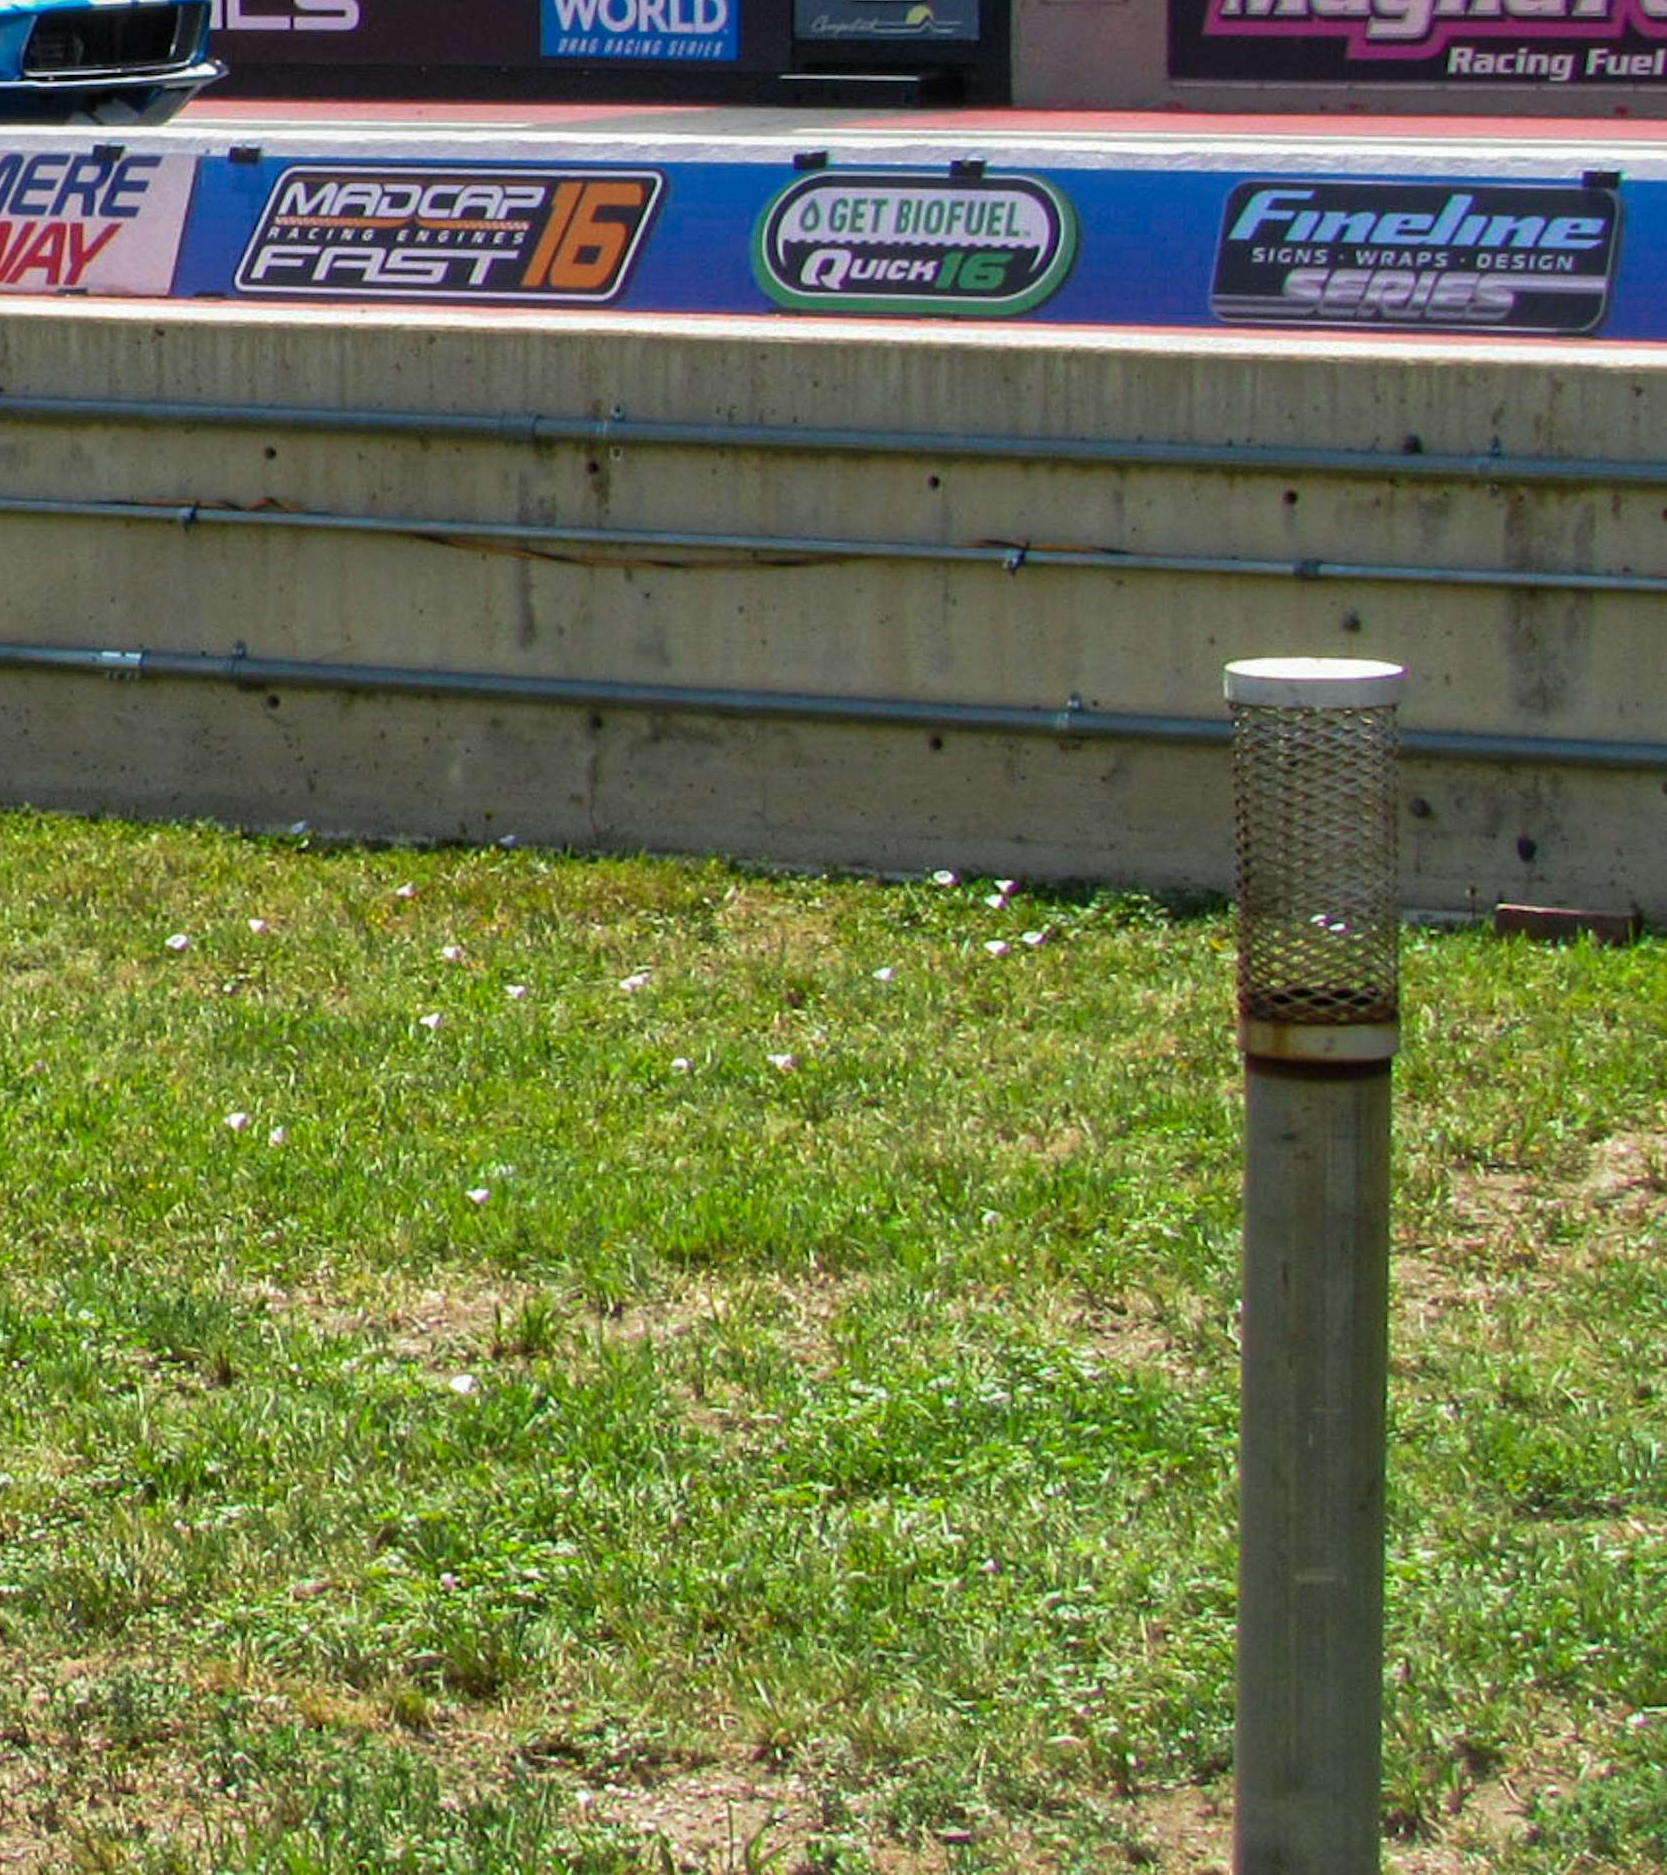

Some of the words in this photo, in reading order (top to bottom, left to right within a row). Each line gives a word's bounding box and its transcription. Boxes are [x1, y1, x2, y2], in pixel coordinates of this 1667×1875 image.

[603, 39, 663, 56] RACING
[667, 40, 724, 58] SERIES
[1447, 47, 1573, 82] Racing
[266, 225, 375, 242] RACING
[396, 228, 526, 244] ENGINES
[278, 181, 546, 220] MADCAP
[519, 181, 643, 289] 16
[828, 198, 889, 234] GET
[895, 199, 1022, 238] BIOFUEL
[1228, 190, 1606, 250] Fineline
[250, 245, 521, 286] FAST
[1251, 246, 1328, 266] SIGNS
[1355, 250, 1449, 269] WRAPS
[1476, 252, 1574, 271] DESIGN
[1281, 268, 1516, 322] SERIES
